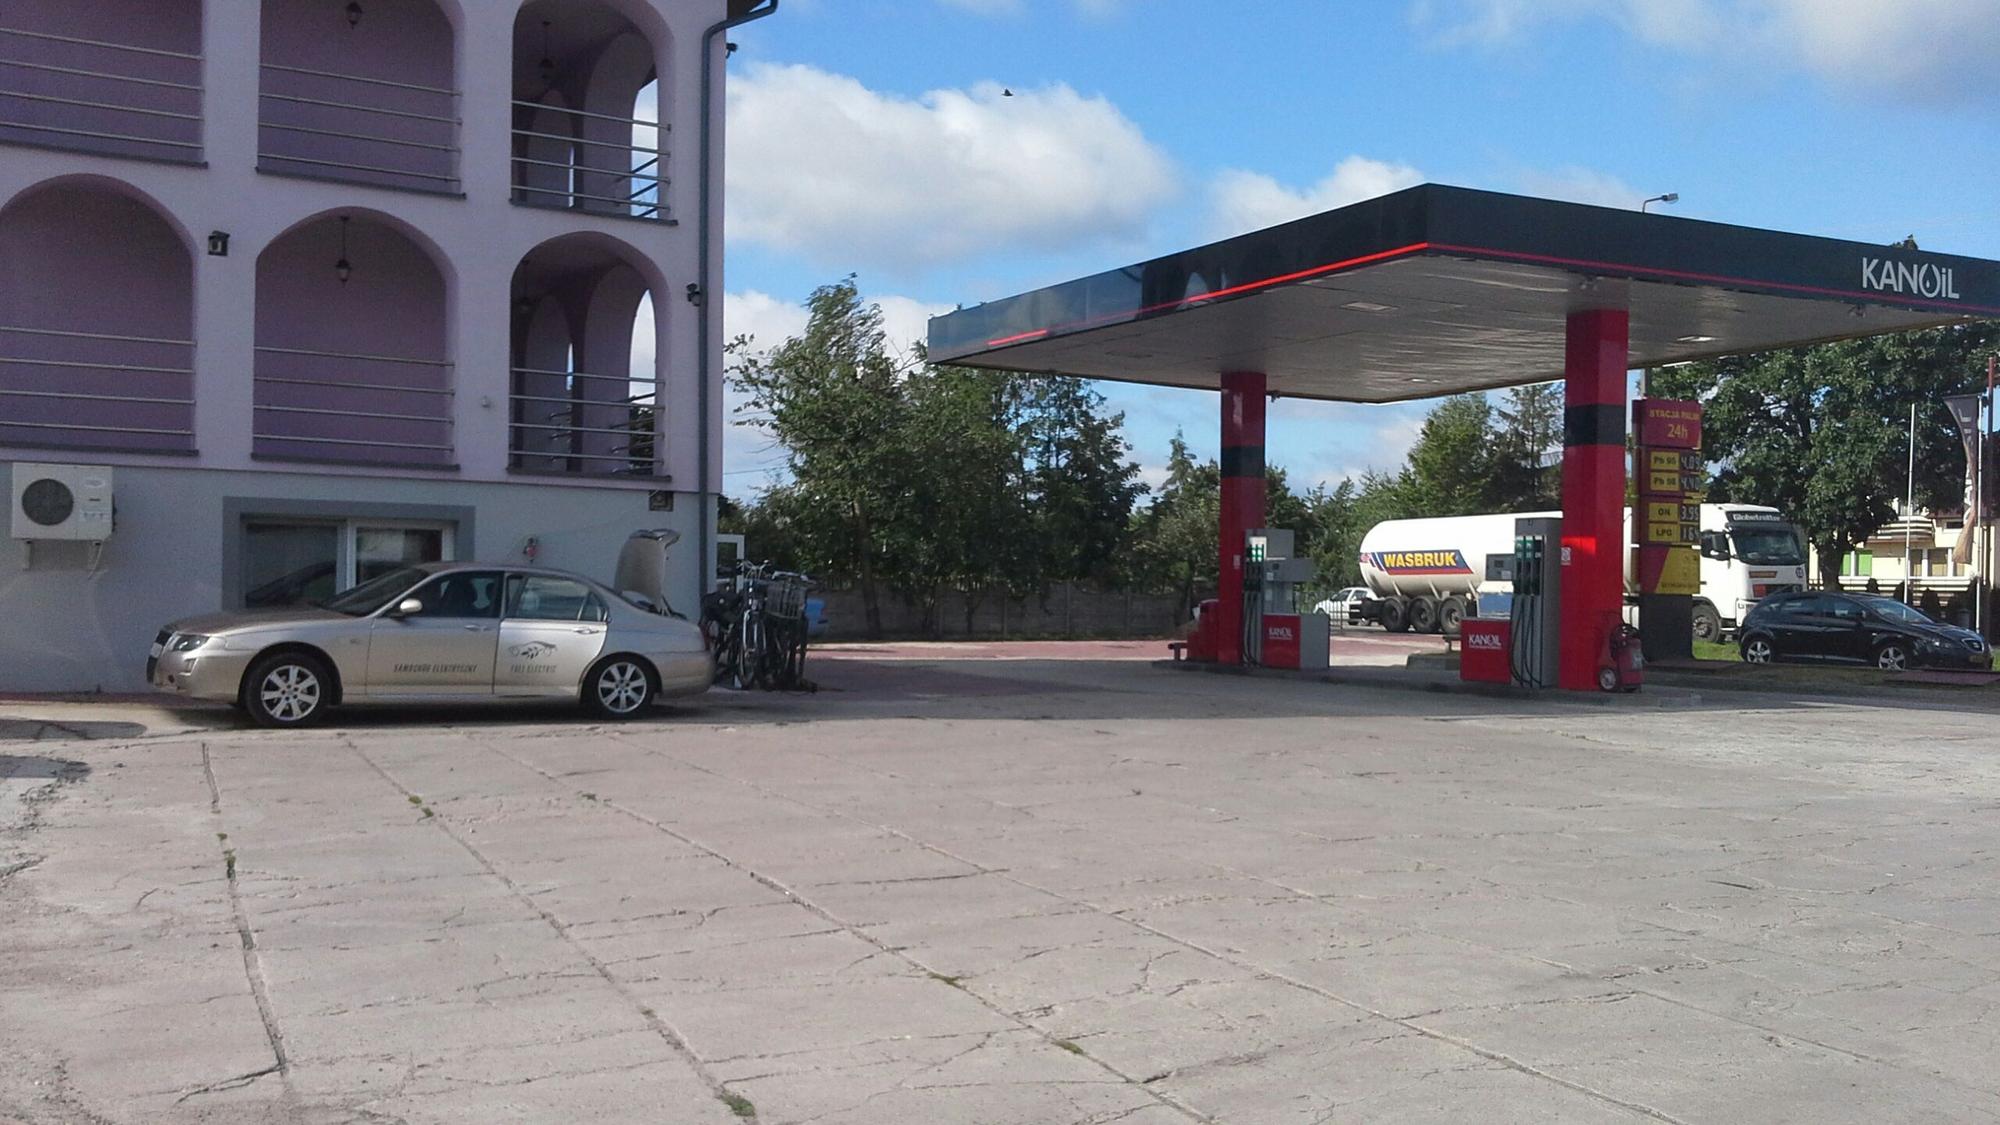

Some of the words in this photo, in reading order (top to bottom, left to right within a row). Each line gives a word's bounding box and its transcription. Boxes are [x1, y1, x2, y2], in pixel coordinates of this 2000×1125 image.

[1667, 423, 1688, 439] 24h
[1657, 506, 1671, 517] ON
[1655, 528, 1673, 537] LPG
[1383, 552, 1457, 568] WASBRUK
